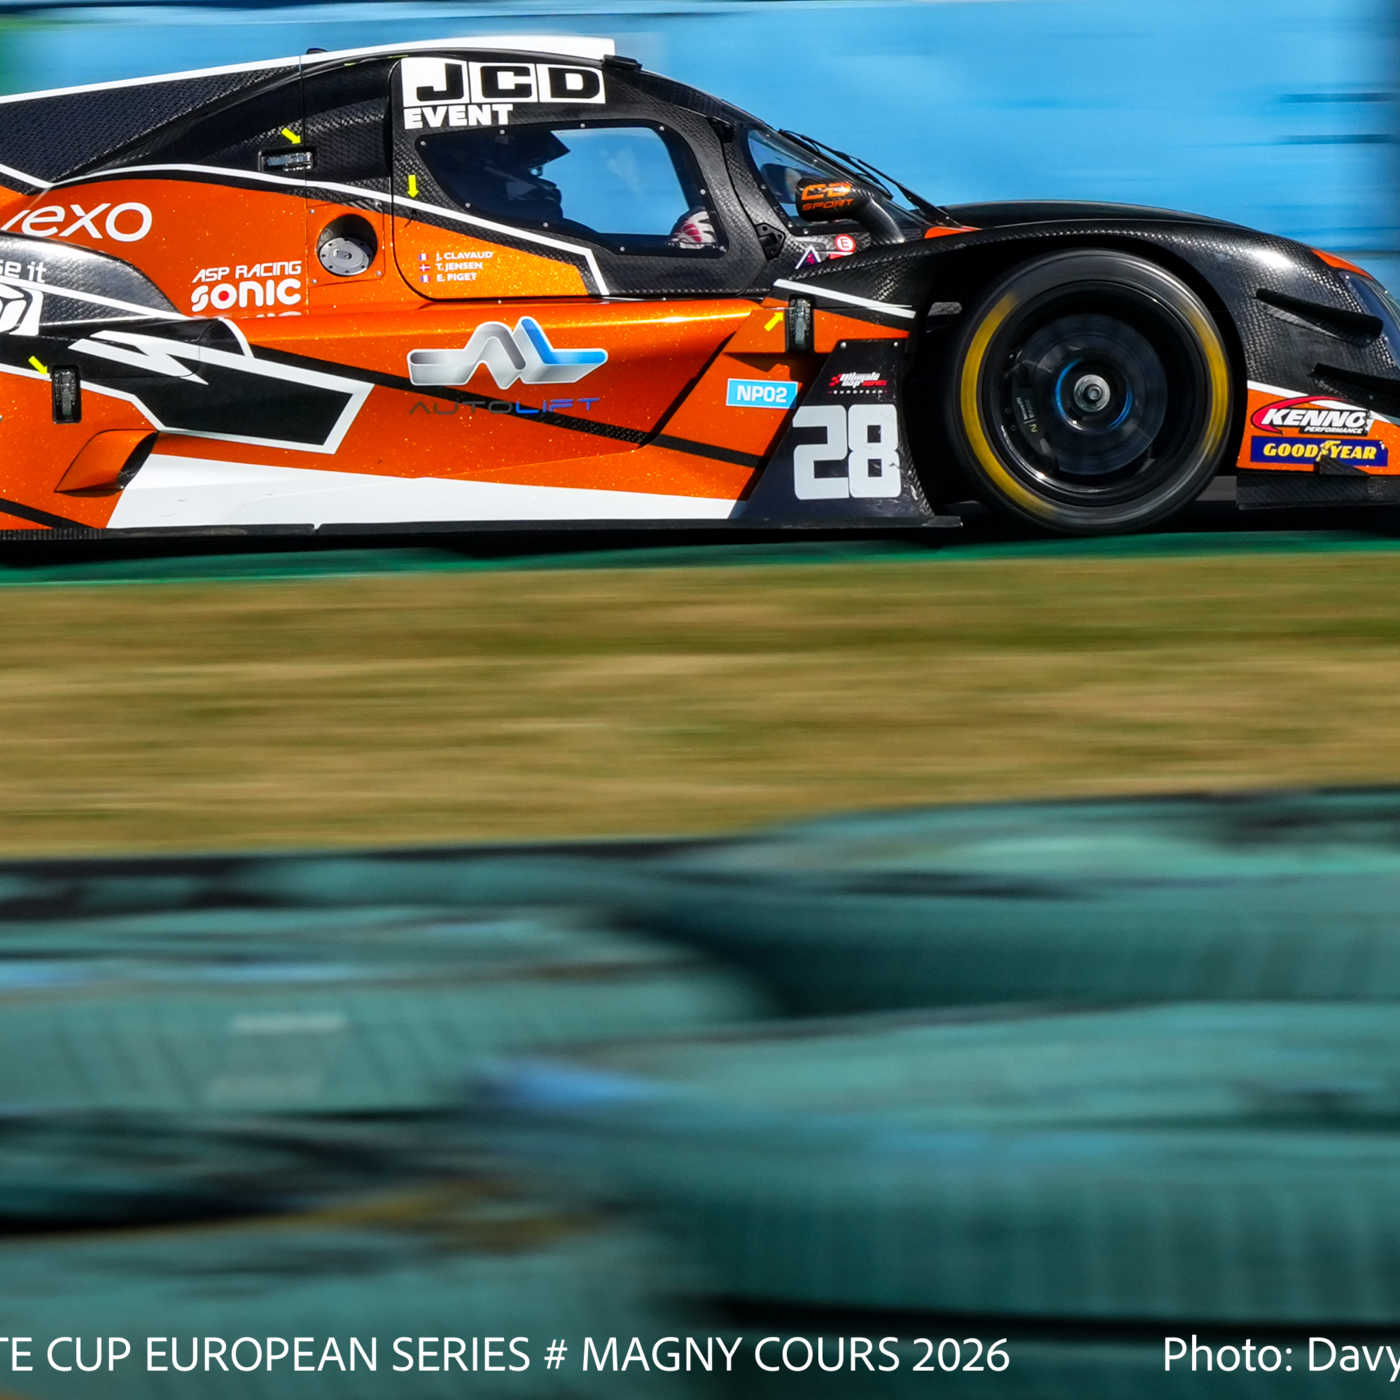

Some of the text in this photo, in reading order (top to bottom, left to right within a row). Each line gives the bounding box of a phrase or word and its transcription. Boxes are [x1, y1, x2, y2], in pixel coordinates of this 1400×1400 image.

[416, 63, 600, 102] JCD
[404, 103, 513, 130] EVENT
[27, 262, 47, 284] it
[192, 260, 302, 283] ASP RACING
[410, 398, 600, 415] AUTOLIFT
[1304, 426, 1364, 435] PERFORMANCE
[792, 404, 901, 500] 28
